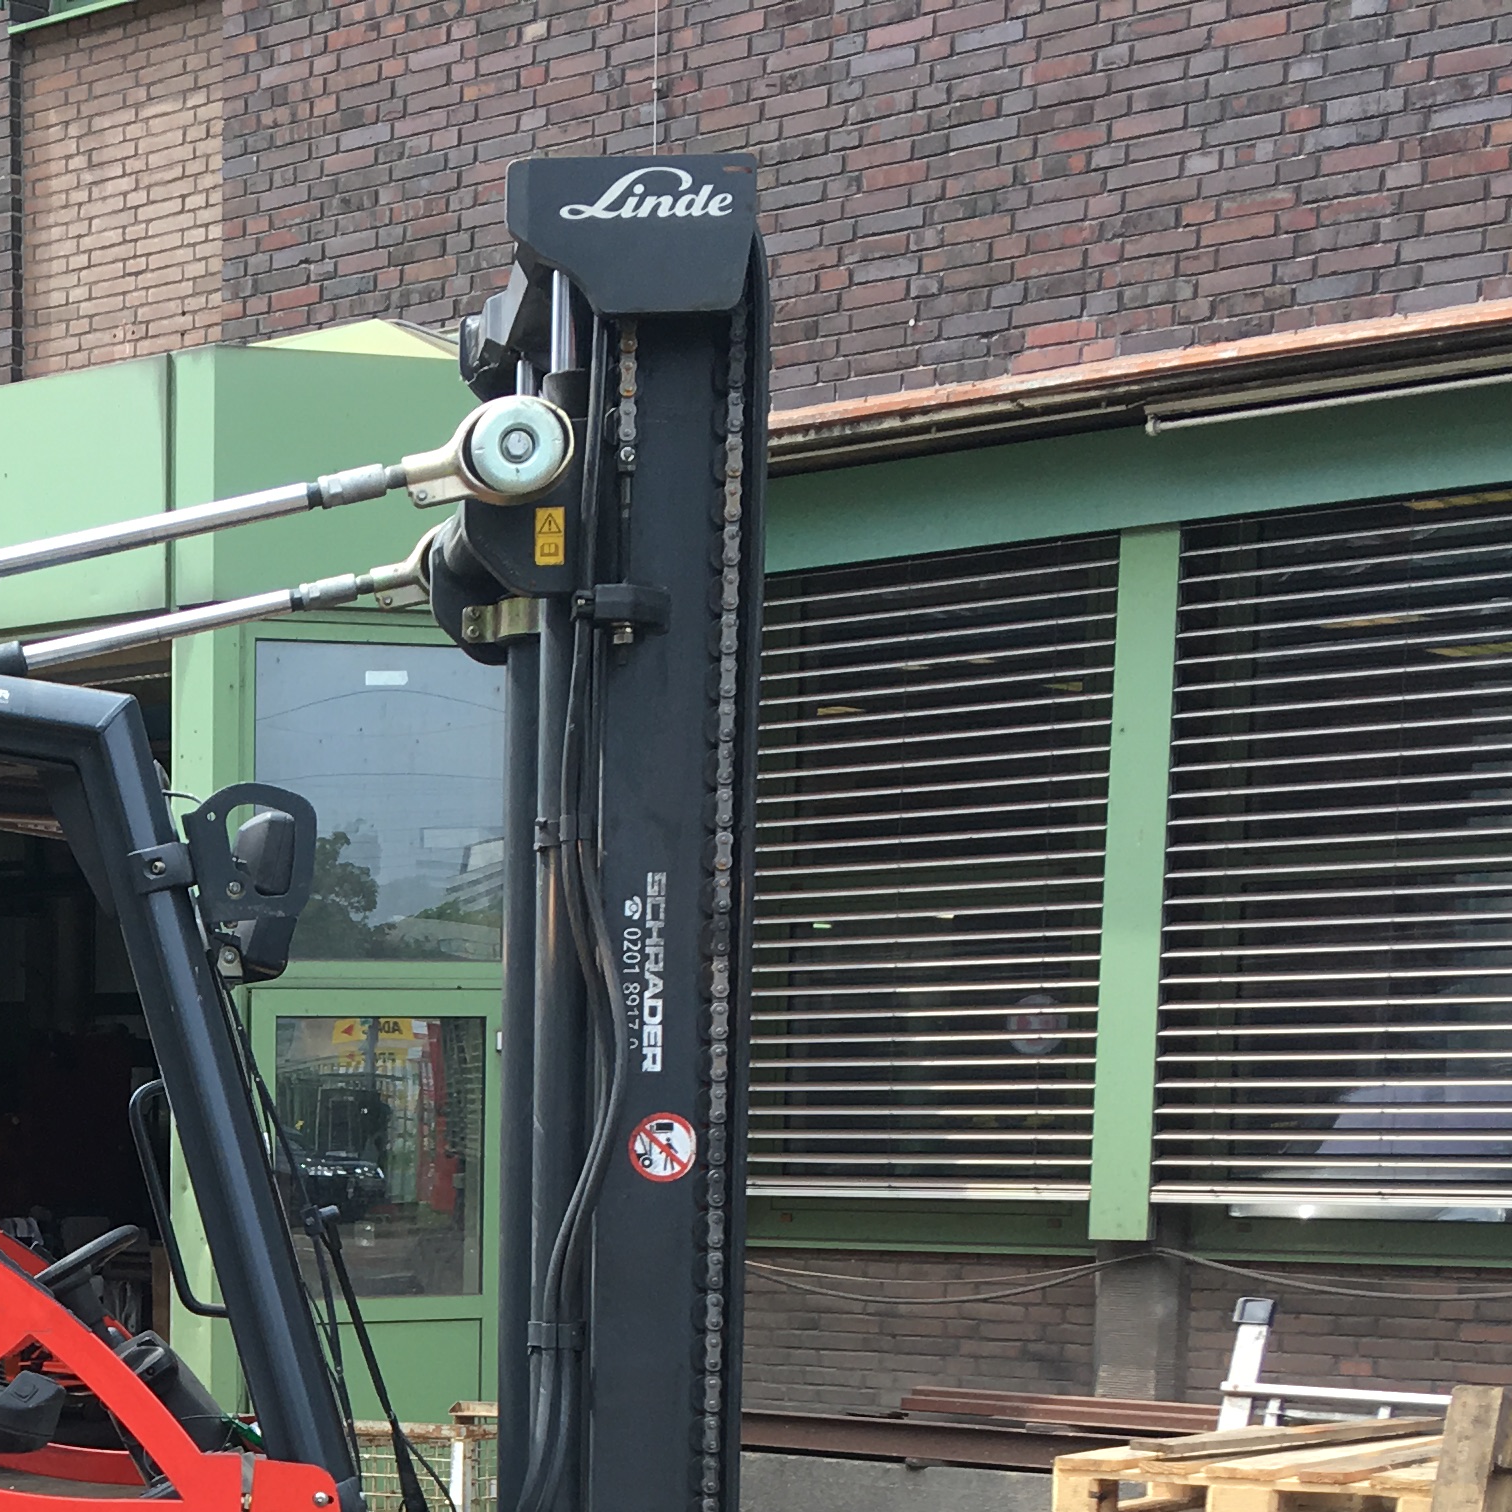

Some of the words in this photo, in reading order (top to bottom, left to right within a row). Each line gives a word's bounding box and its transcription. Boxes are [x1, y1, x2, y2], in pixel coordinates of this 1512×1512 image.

[559, 166, 733, 220] Linde
[623, 927, 642, 974] 0201
[641, 871, 667, 1073] SCHRADER
[622, 982, 641, 1032] 8917
